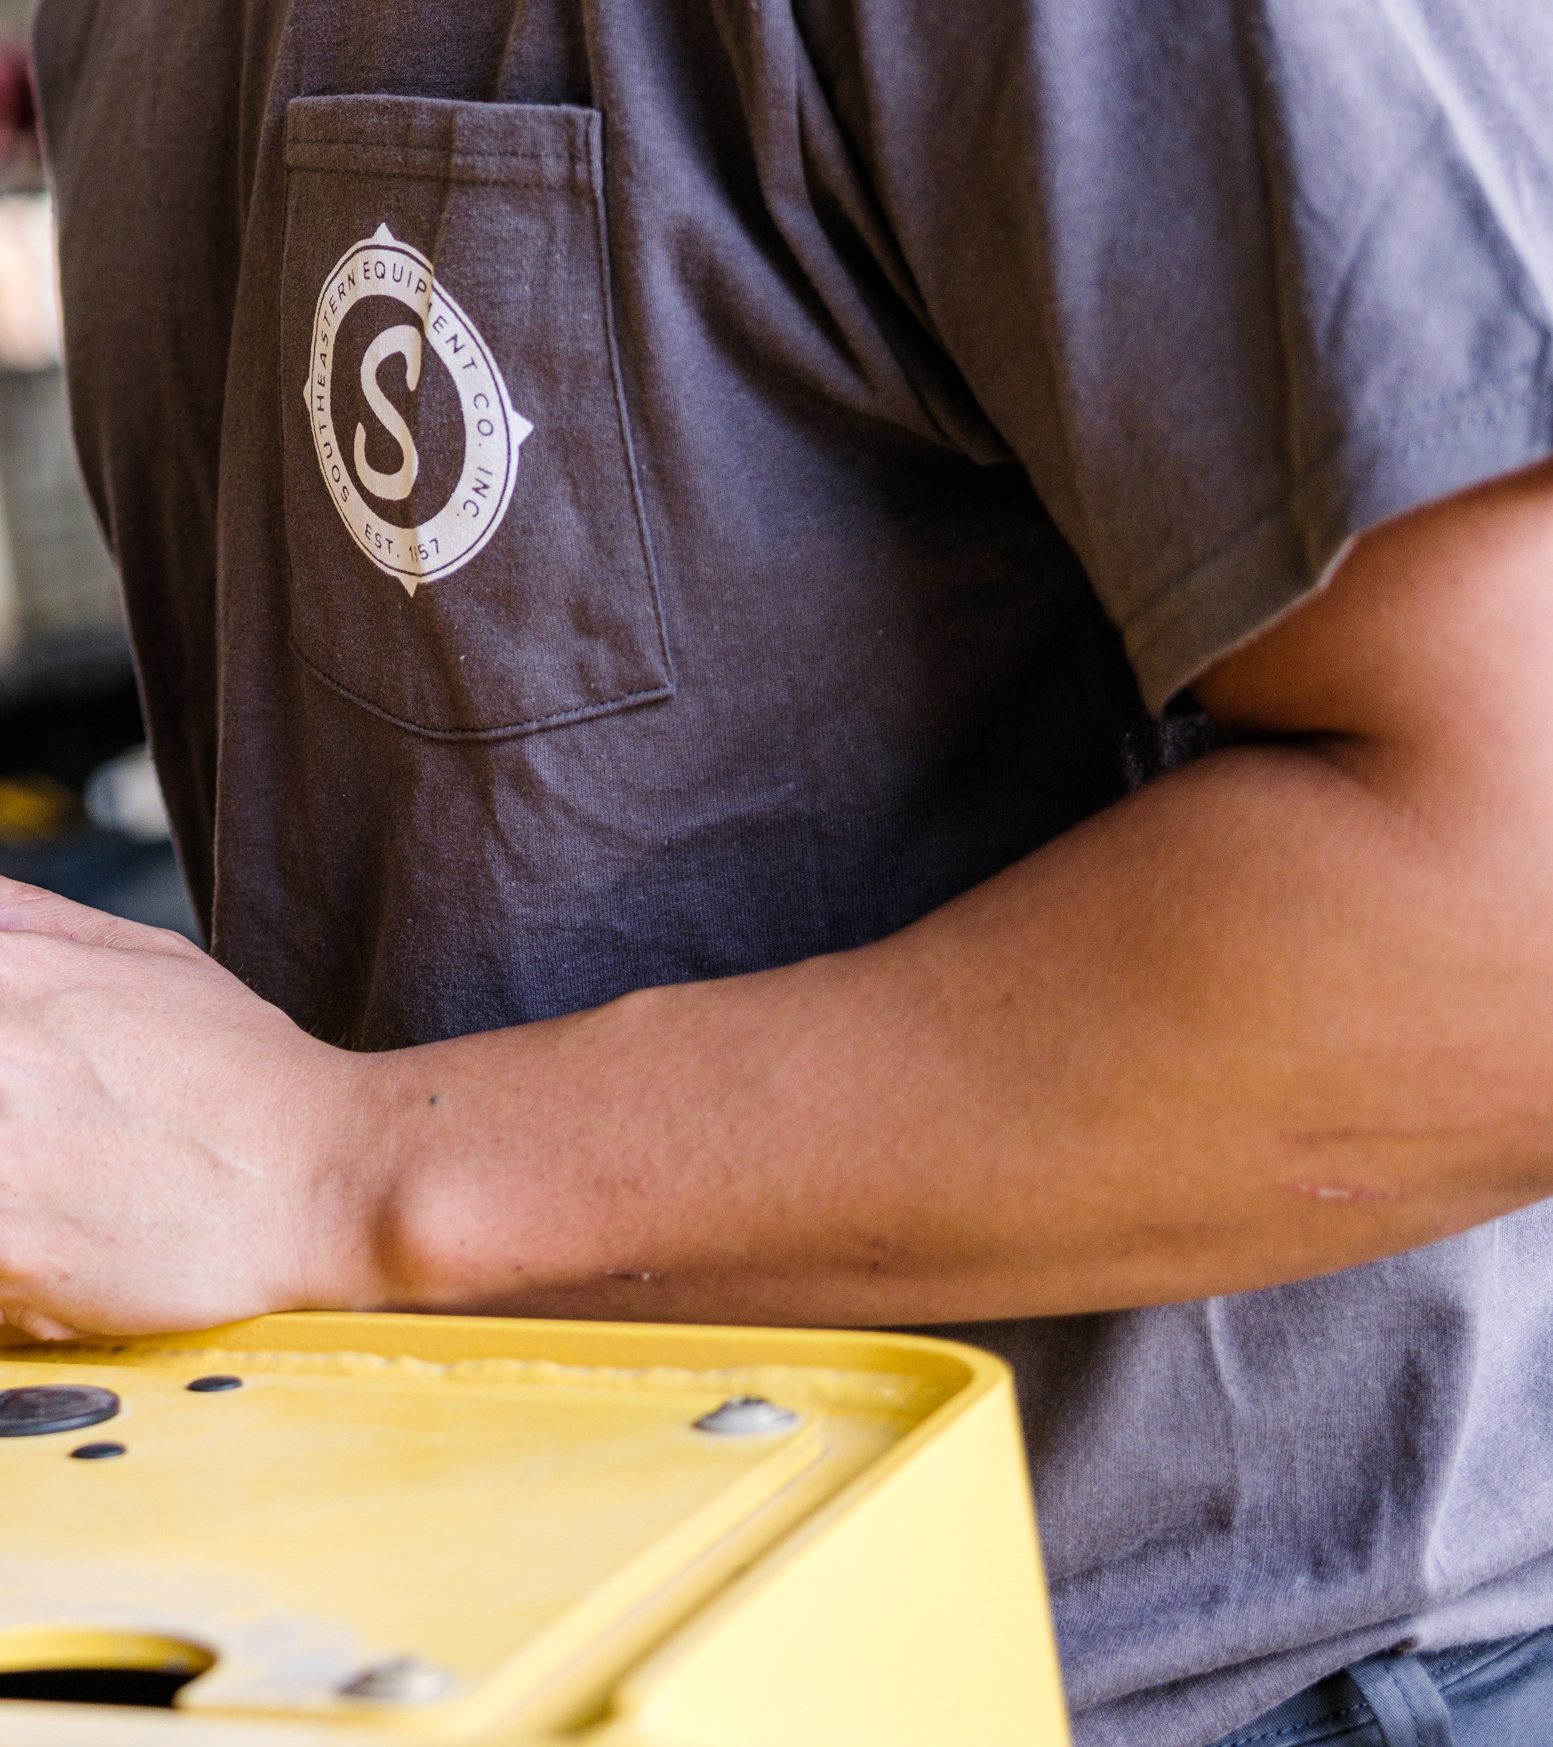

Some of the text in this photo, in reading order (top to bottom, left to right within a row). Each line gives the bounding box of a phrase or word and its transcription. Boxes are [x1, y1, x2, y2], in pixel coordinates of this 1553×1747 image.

[316, 269, 356, 503] SOUTHEASTERN
[362, 260, 479, 370] EQUIPENT
[353, 324, 422, 501] S
[365, 523, 400, 559] EST.
